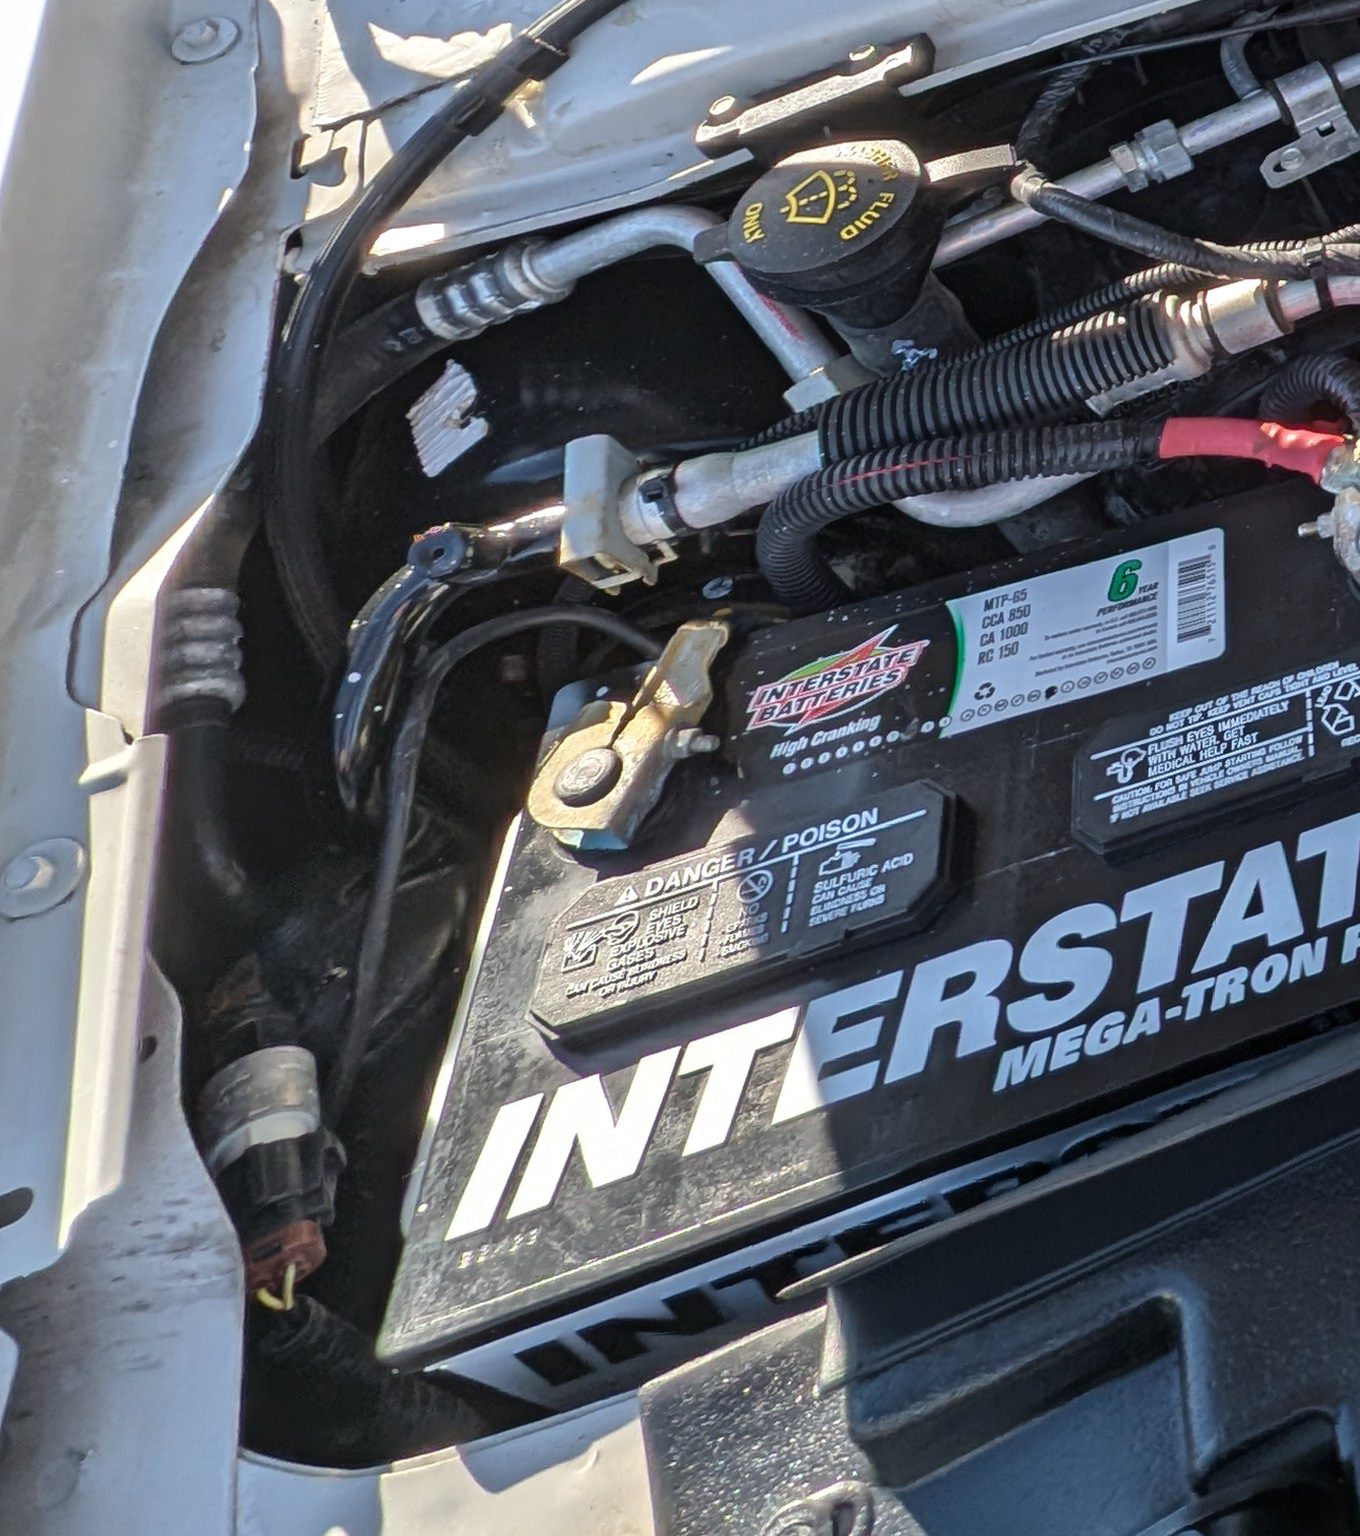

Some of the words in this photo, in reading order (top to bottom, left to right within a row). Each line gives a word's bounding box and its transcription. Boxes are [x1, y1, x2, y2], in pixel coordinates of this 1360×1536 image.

[742, 202, 767, 244] ONLY
[840, 191, 895, 240] FLUID
[1107, 556, 1142, 604] 6
[1138, 581, 1158, 595] YEAR
[983, 587, 1027, 612] MTP-65
[1097, 590, 1158, 617] PERFORMANCE
[981, 610, 1004, 630] CCA
[1007, 603, 1030, 623] 850
[979, 629, 996, 647] CA
[999, 621, 1027, 642] 1000
[977, 647, 994, 665] RC
[998, 640, 1018, 659] 150
[759, 647, 917, 703] INTERSTATE
[760, 668, 902, 720] BATTERIES
[1149, 725, 1163, 736] DO
[1166, 718, 1184, 730] NOT
[1207, 704, 1229, 717] KEEP
[1312, 672, 1329, 683] AND
[770, 735, 808, 759] High
[810, 715, 881, 746] Cranking
[1148, 735, 1182, 754] FLUSH
[1187, 725, 1214, 741] EYES
[1220, 701, 1287, 731] IMMEDIATELY
[1148, 753, 1194, 776] MEDICAL
[1200, 742, 1227, 759] HELP
[1231, 733, 1257, 749] FAST
[1149, 749, 1176, 765] WITH
[1180, 734, 1219, 754] WATER.
[1224, 726, 1244, 740] GET
[1176, 770, 1196, 783] SAFE
[647, 847, 753, 895] DANGER
[782, 807, 878, 853] POISON
[814, 865, 878, 893] SULFURIC
[882, 853, 914, 871] ACID
[810, 890, 866, 915] BLINDNESS
[811, 889, 836, 905] CAN
[837, 878, 872, 896] CAUSE
[648, 895, 699, 921] SHIELD
[737, 902, 760, 918] NO
[644, 913, 684, 935] EYES
[610, 925, 685, 956] EXPLOSIVE
[564, 980, 587, 996] CAN
[591, 968, 625, 987] CAUSE
[628, 950, 685, 976] BLINDNESS
[606, 947, 654, 970] GASES
[598, 983, 617, 996] OR
[618, 970, 655, 989] INJURY
[992, 936, 1329, 1093] MEGA-TRON
